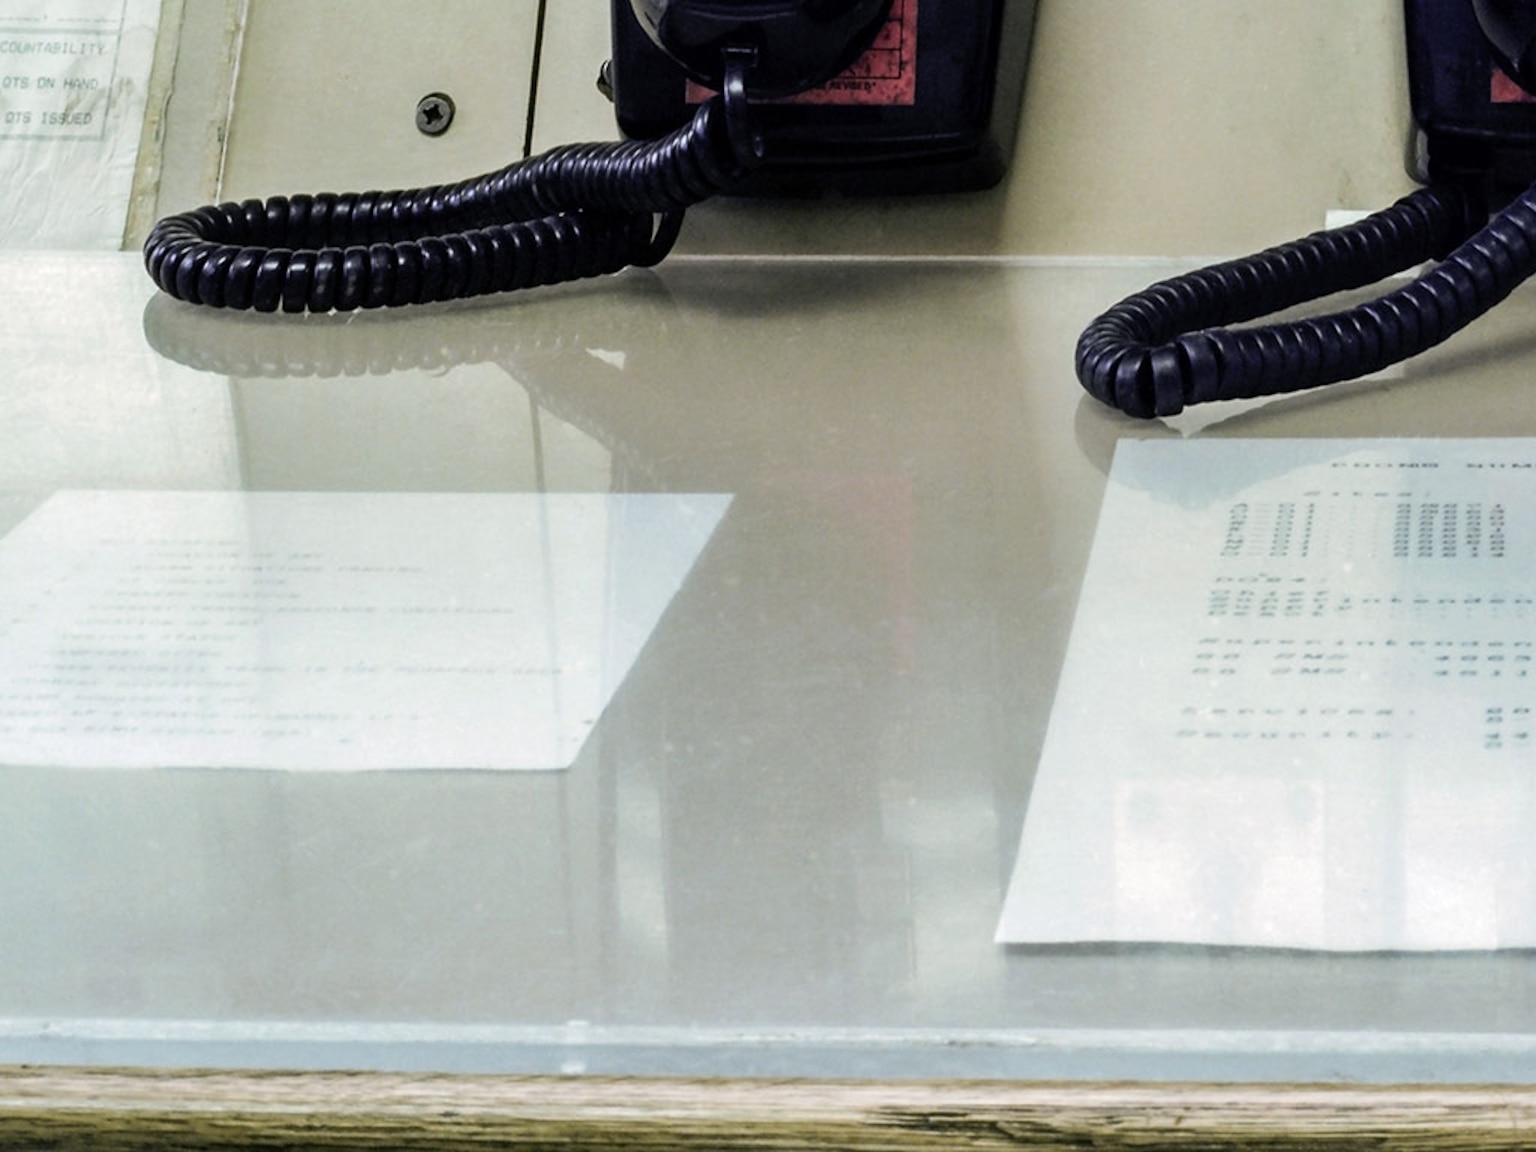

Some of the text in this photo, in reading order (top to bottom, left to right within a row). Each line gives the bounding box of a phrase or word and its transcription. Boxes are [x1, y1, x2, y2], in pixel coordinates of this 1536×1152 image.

[37, 76, 55, 89] ON
[63, 77, 99, 90] HAND
[41, 111, 93, 125] ISSUED
